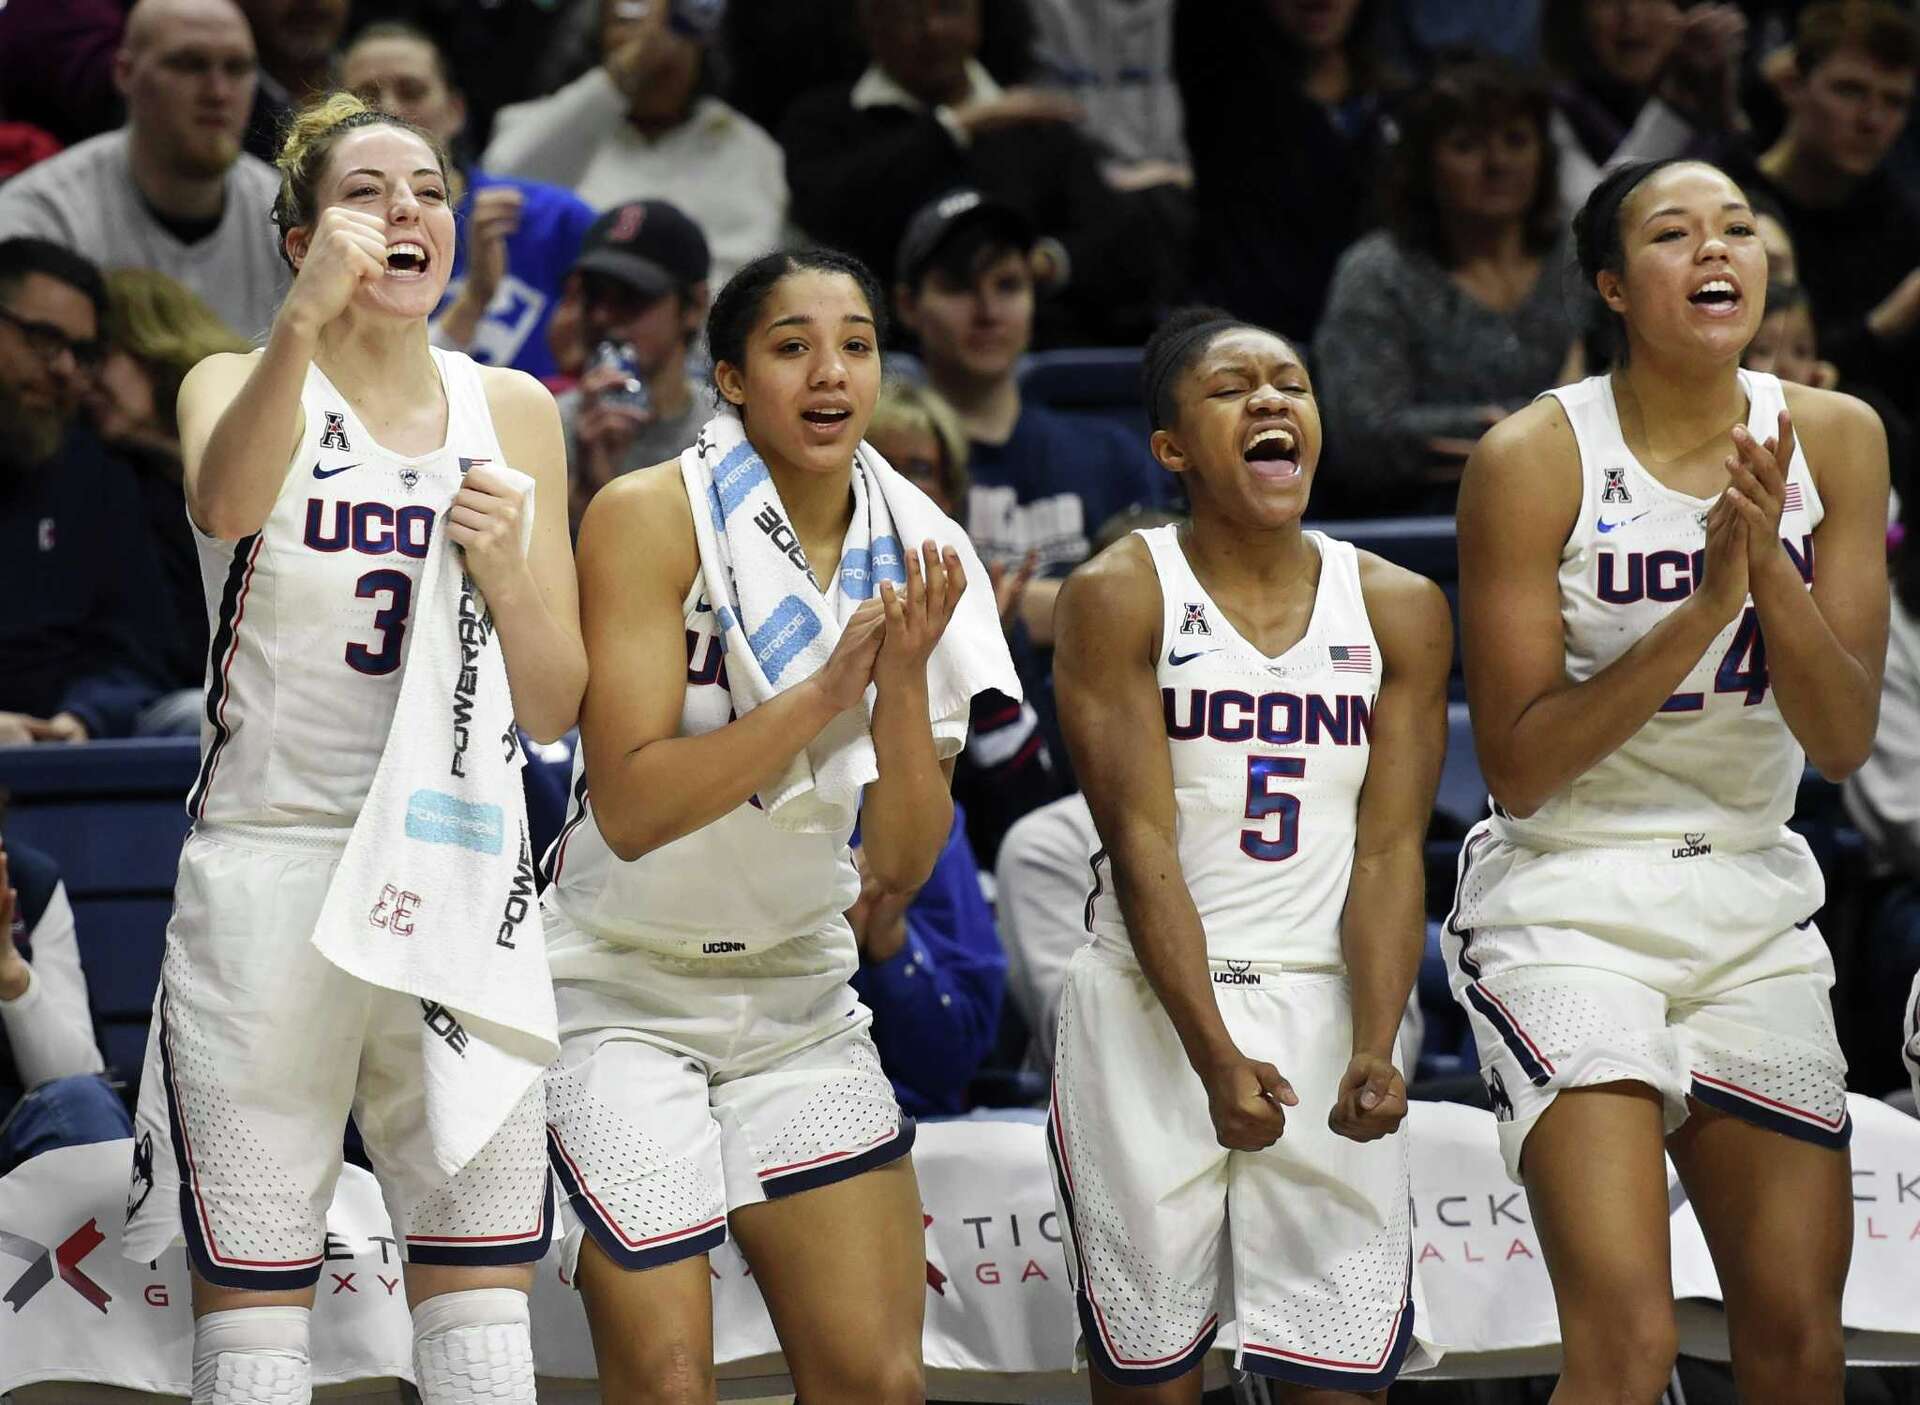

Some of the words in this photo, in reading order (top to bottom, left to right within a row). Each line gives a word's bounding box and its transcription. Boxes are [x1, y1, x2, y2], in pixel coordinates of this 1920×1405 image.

[303, 498, 436, 558] UCO
[1597, 533, 1815, 605] UCN
[1161, 687, 1376, 746] UCONN
[1239, 755, 1307, 862] 5
[1671, 844, 1711, 859] UCONN
[702, 941, 746, 954] UCONN
[1213, 972, 1261, 984] UCONN
[963, 1211, 1064, 1249] TIC
[1418, 1237, 1534, 1264] ALA
